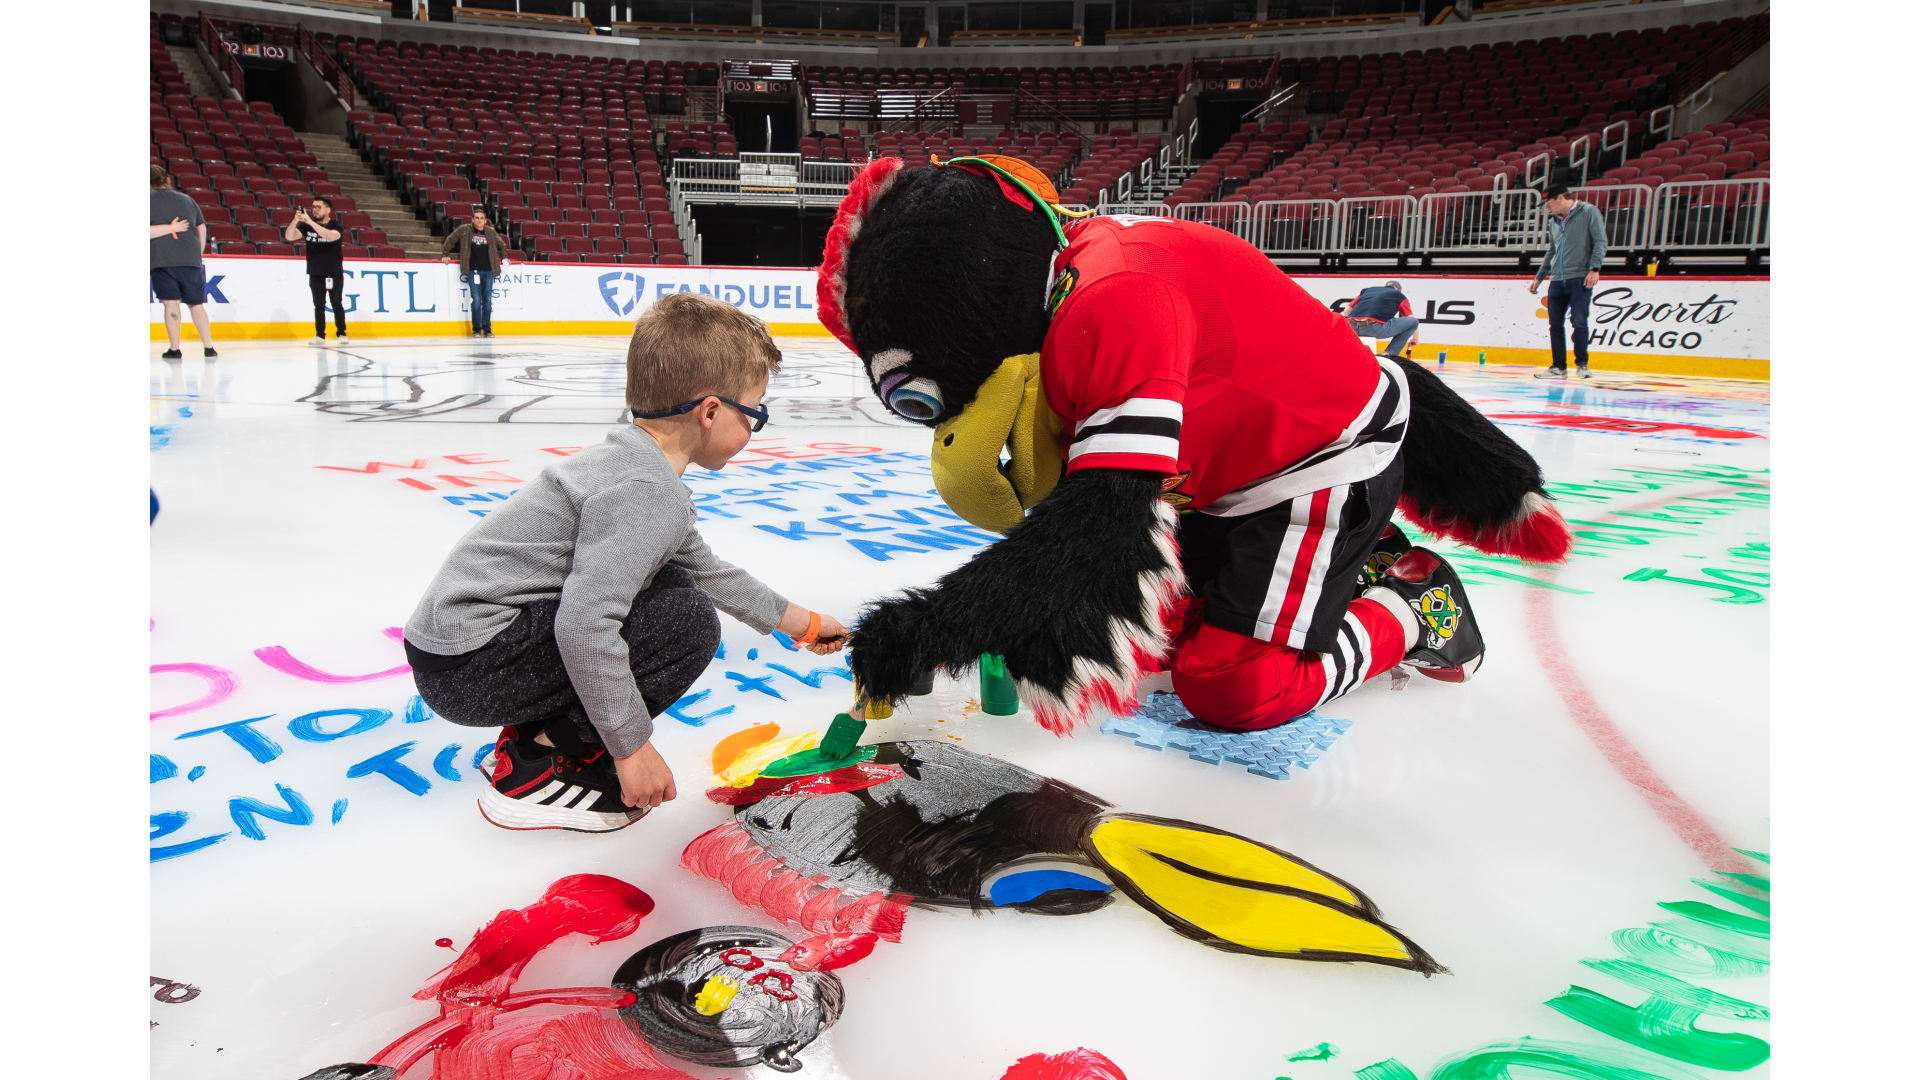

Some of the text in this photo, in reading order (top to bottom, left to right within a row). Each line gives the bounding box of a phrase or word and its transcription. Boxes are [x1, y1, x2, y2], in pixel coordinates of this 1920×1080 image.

[262, 45, 285, 59] 103
[733, 81, 751, 92] 103
[459, 274, 552, 285] GRANTEE
[459, 288, 509, 298] TST
[1592, 287, 1738, 332] Sports
[1587, 328, 1703, 349] HICAGO
